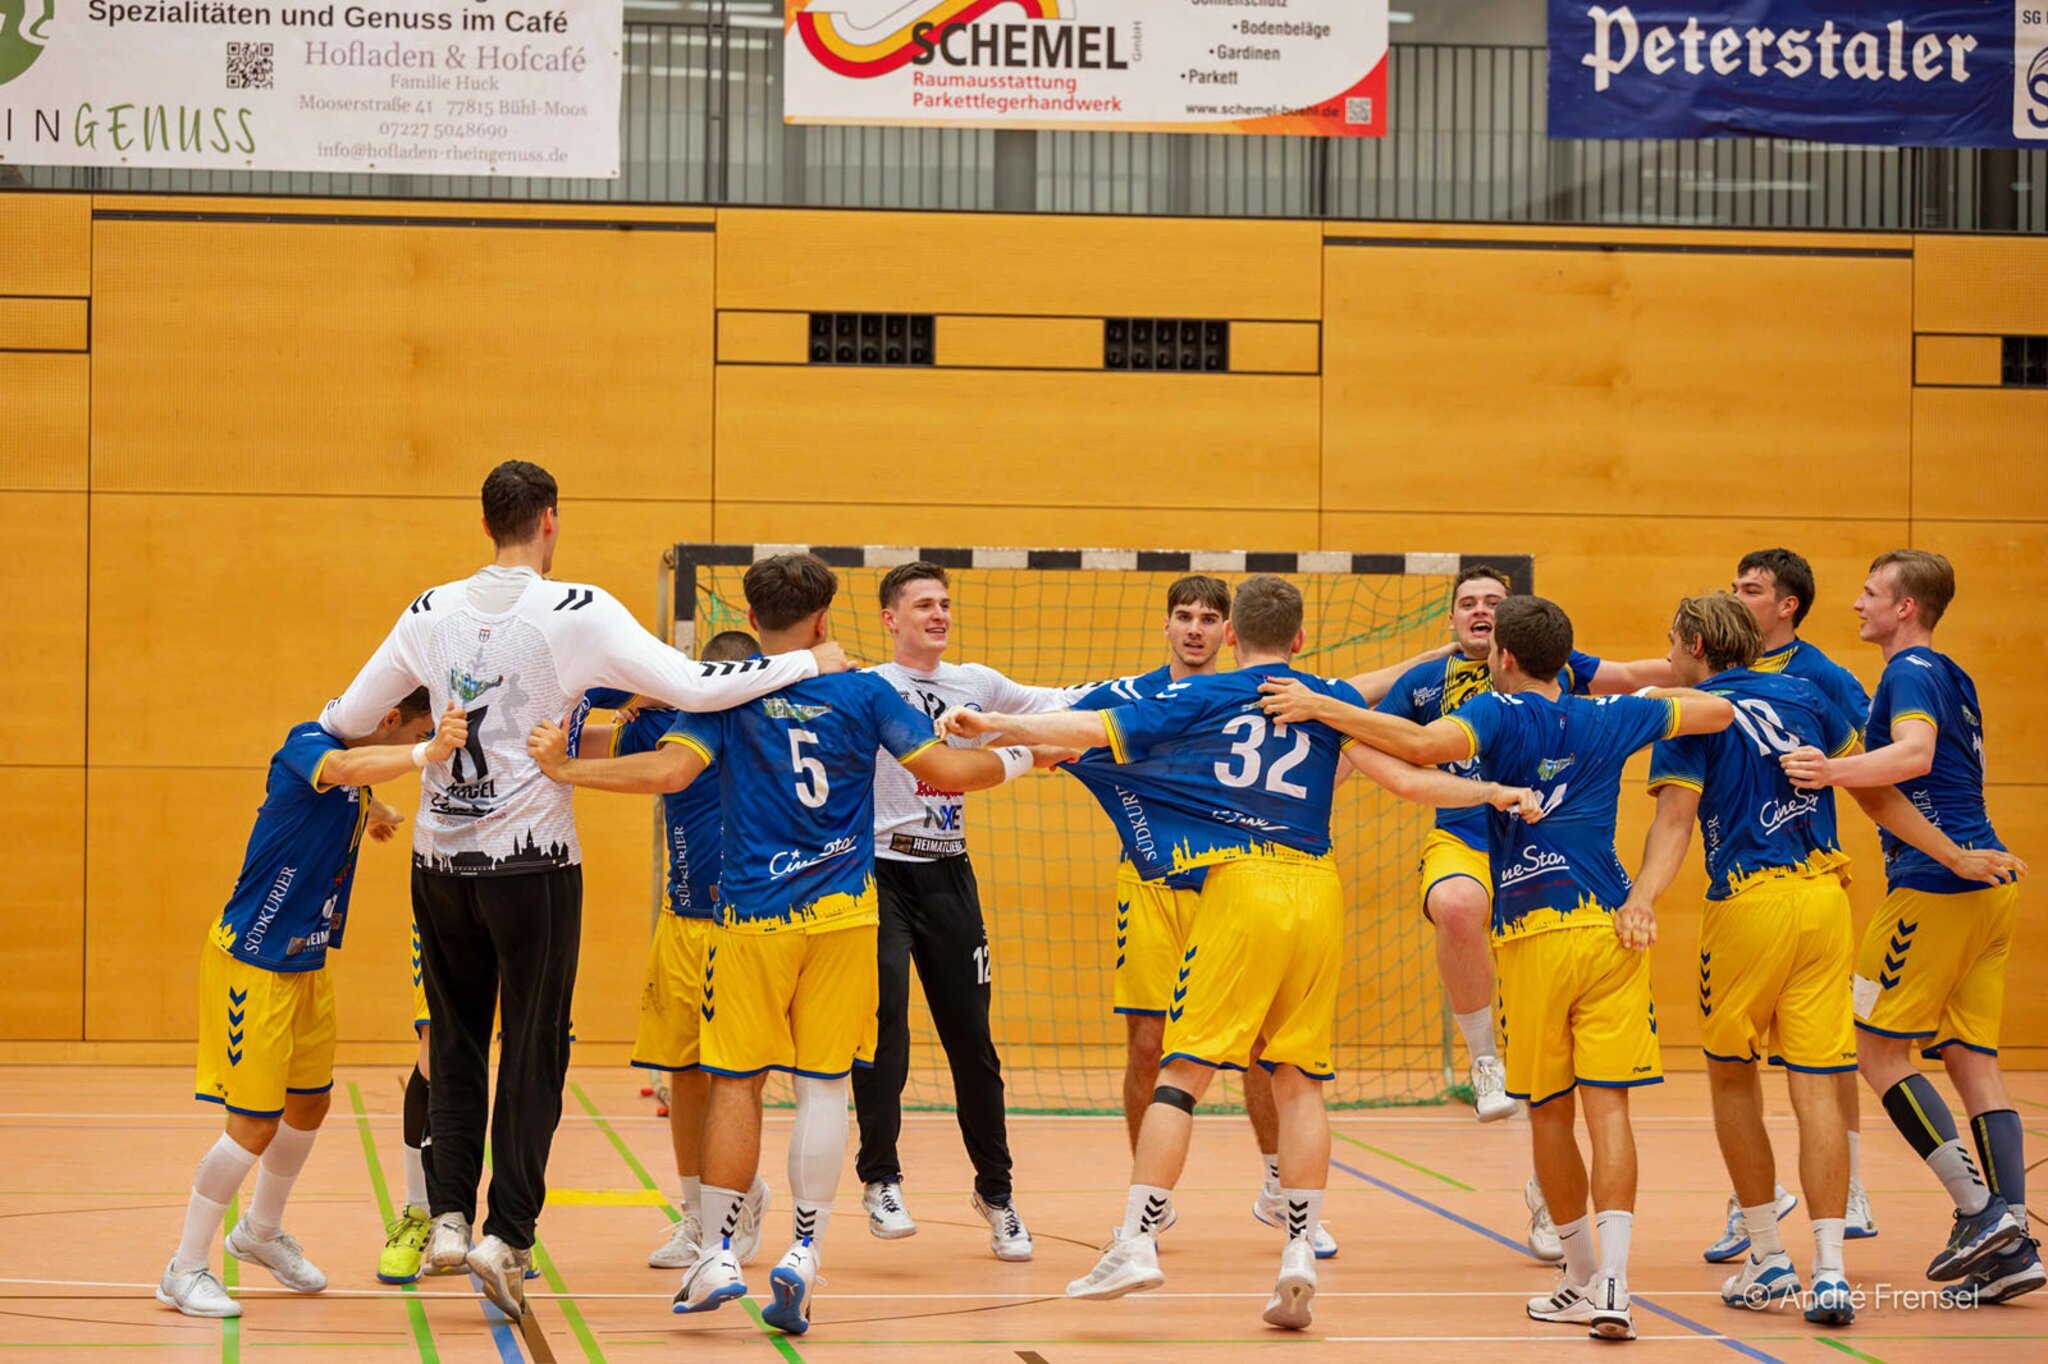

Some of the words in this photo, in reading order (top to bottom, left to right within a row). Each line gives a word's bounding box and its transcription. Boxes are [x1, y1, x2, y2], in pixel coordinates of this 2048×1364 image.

[88, 0, 271, 26] Spezialitäten
[281, 6, 334, 27] und
[344, 7, 452, 30] Genuss
[462, 8, 495, 31] im
[505, 10, 568, 33] Café
[2022, 10, 2042, 24] SG
[1240, 20, 1330, 39] Bodenbeläge
[911, 22, 1128, 70] SCHEMEL
[1132, 21, 1143, 62] GmbH
[1217, 45, 1280, 60] Gardinen
[1581, 5, 1978, 92] Peterstaler
[305, 41, 435, 68] Hofladen
[444, 45, 467, 69] &
[476, 46, 587, 73] Hofcafé
[390, 74, 450, 90] Familie
[456, 76, 499, 91] Huck
[913, 71, 1077, 93] Raumausstattung
[1188, 69, 1238, 85] Parkett
[299, 95, 410, 114] Mooserstraße
[415, 100, 433, 114] 41
[447, 100, 493, 117] 77815
[499, 100, 588, 118] Bühl-Moos
[913, 92, 1122, 113] Parkettlegerhandwerk
[1186, 103, 1339, 118] www.schemel-buehl.de
[380, 122, 428, 138] 07227
[433, 123, 508, 140] 5048690
[317, 142, 569, 163] info@hofladen-rheingenuss.de
[1214, 714, 1311, 799] 32
[788, 728, 830, 808] 5
[244, 865, 297, 955] SÜDKURIER
